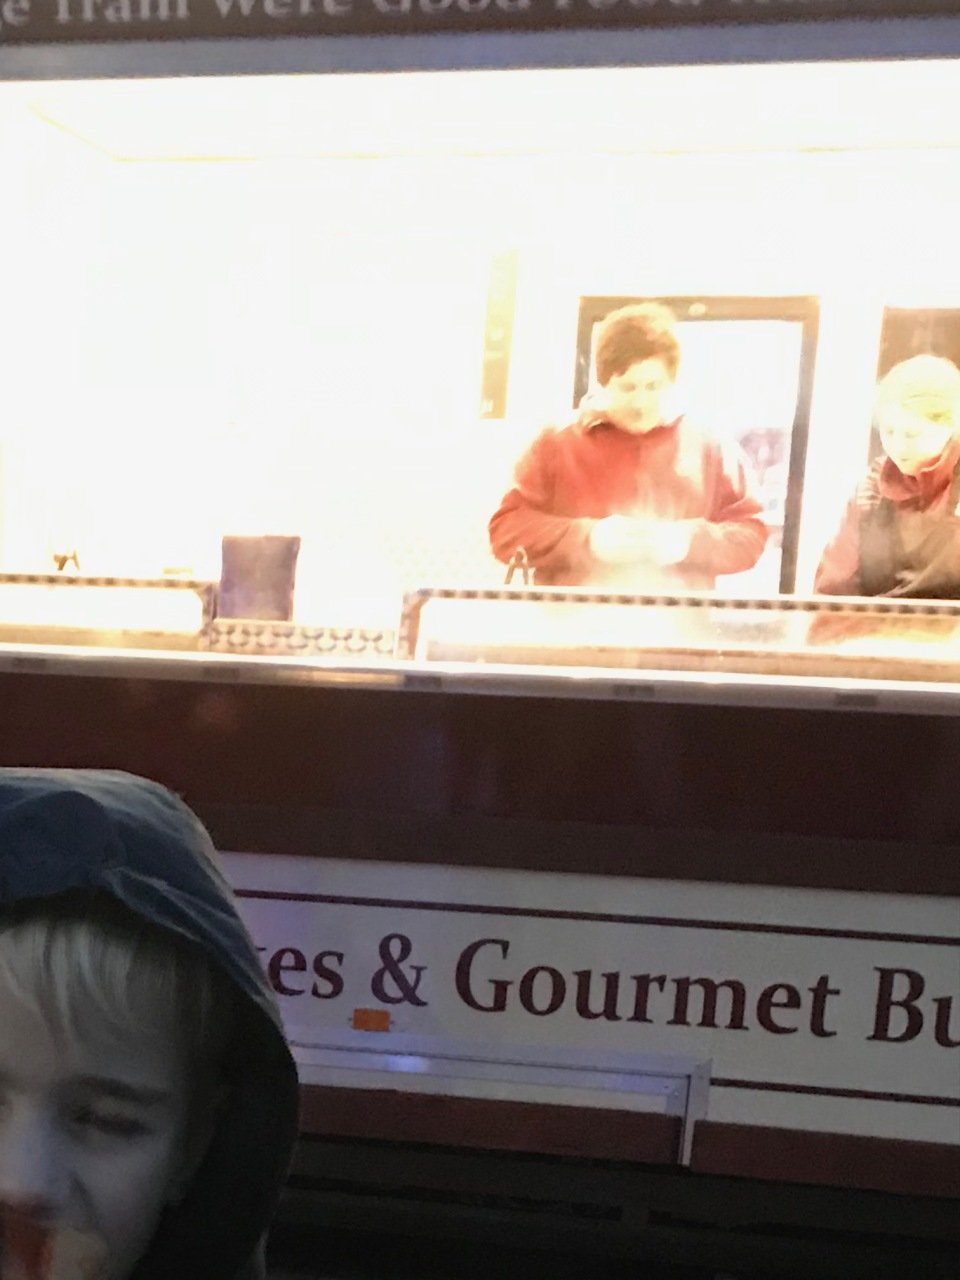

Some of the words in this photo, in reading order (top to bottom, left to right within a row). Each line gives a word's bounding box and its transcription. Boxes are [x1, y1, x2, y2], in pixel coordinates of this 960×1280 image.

[257, 946, 345, 1000] es
[370, 933, 428, 1007] &
[454, 938, 841, 1039] Gourmet
